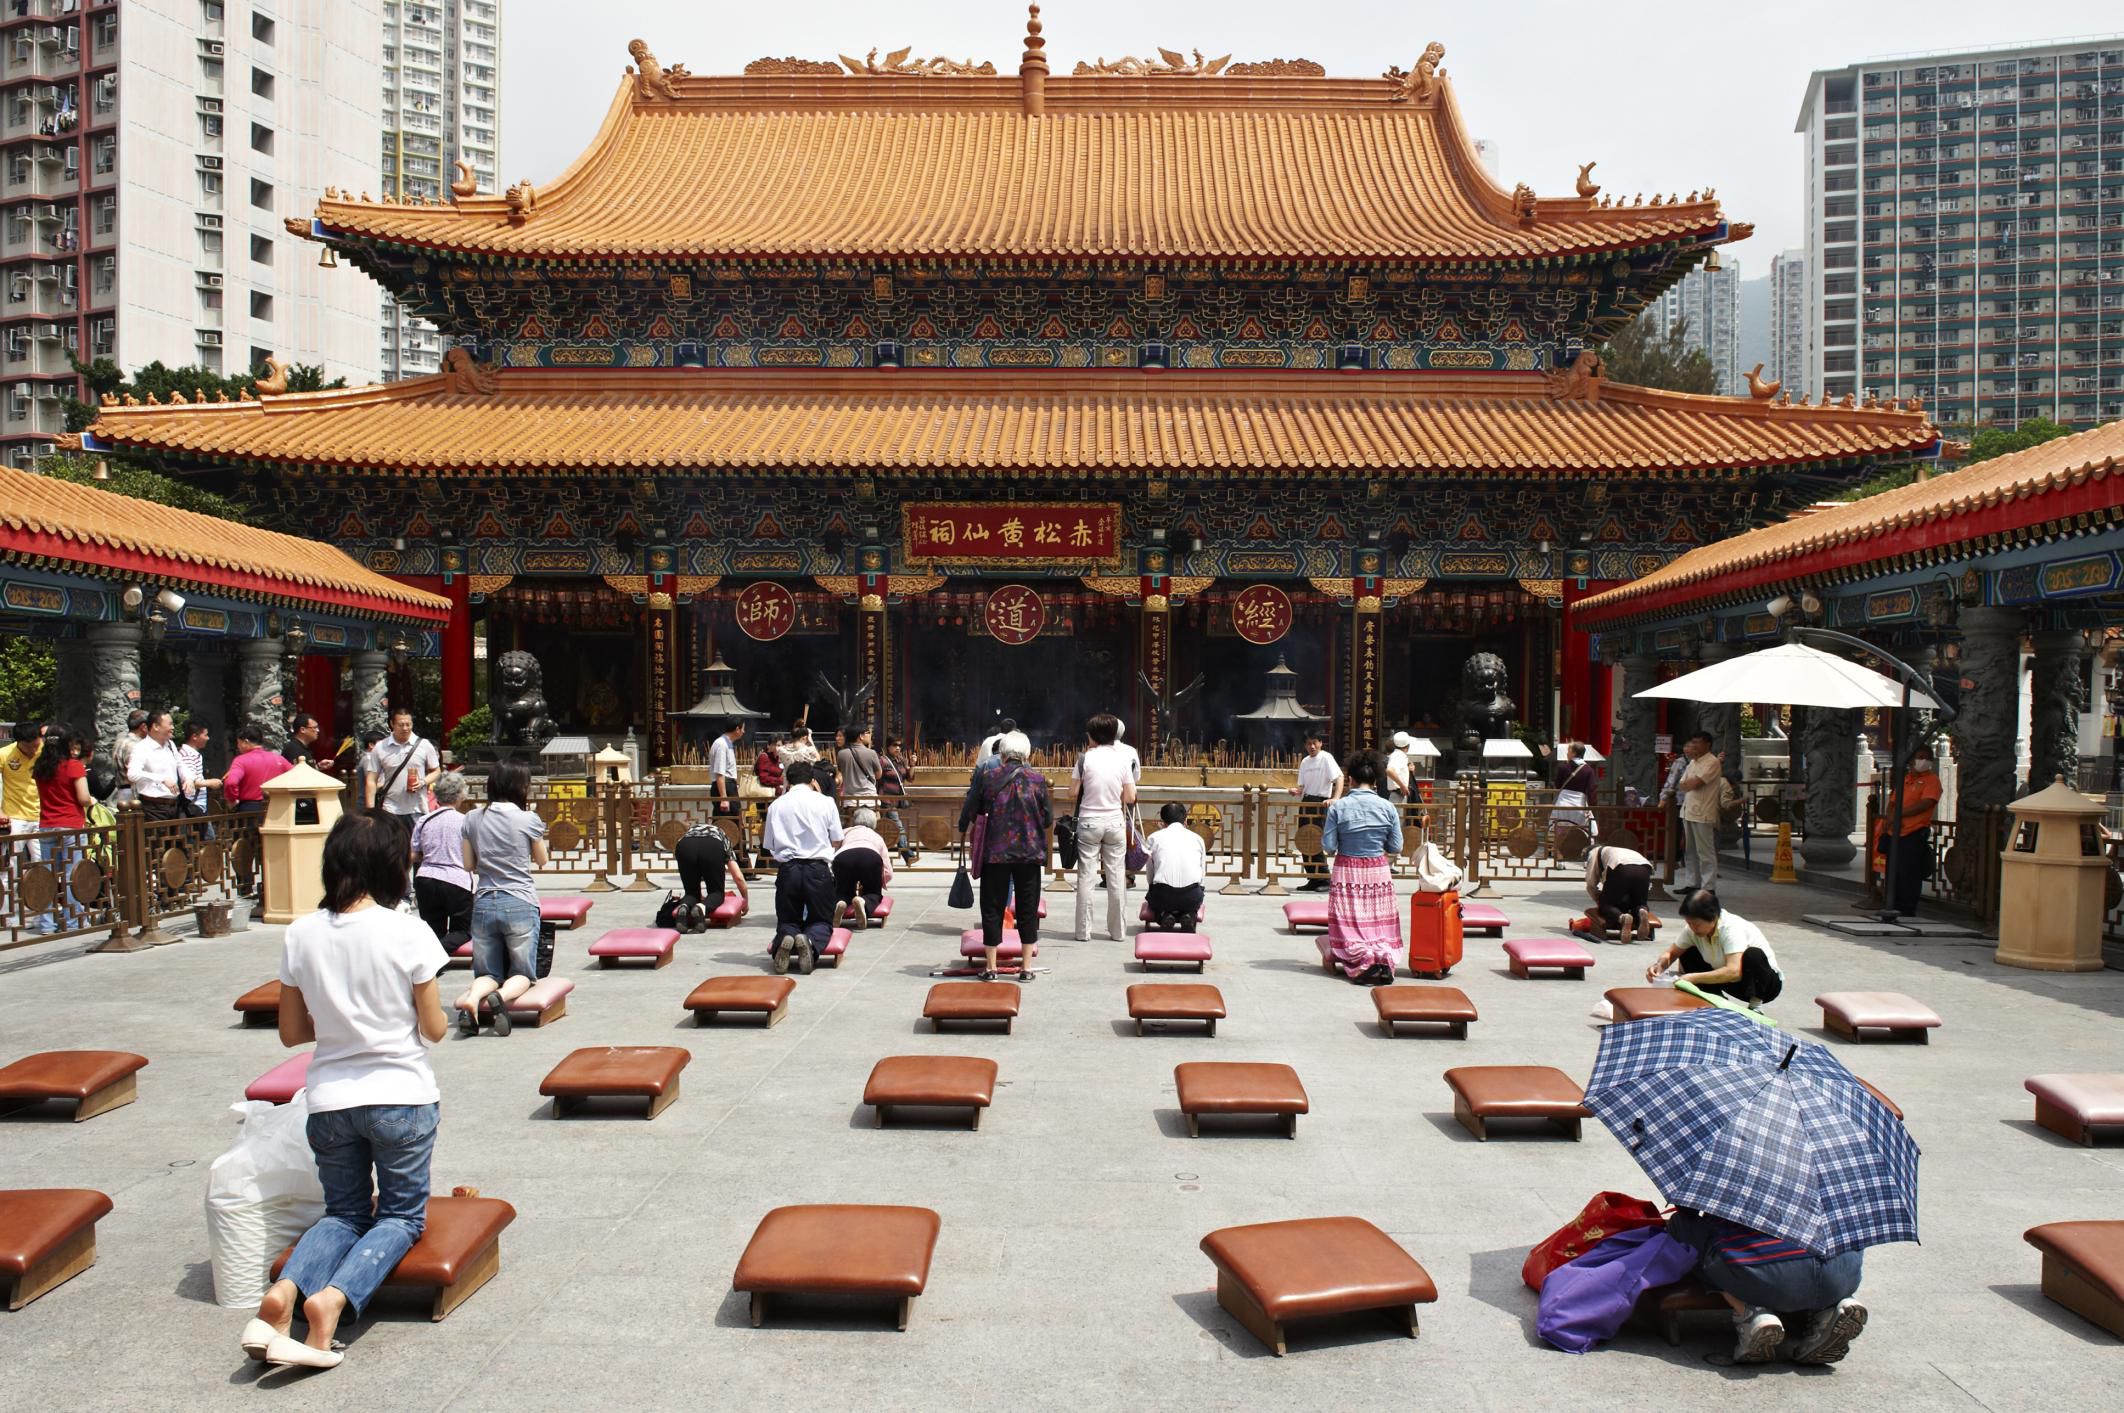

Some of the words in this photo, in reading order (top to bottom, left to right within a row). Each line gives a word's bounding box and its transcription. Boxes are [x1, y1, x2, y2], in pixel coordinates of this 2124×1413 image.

[750, 594, 780, 628] 師
[998, 597, 1031, 632] 道
[1244, 600, 1276, 629] 經
